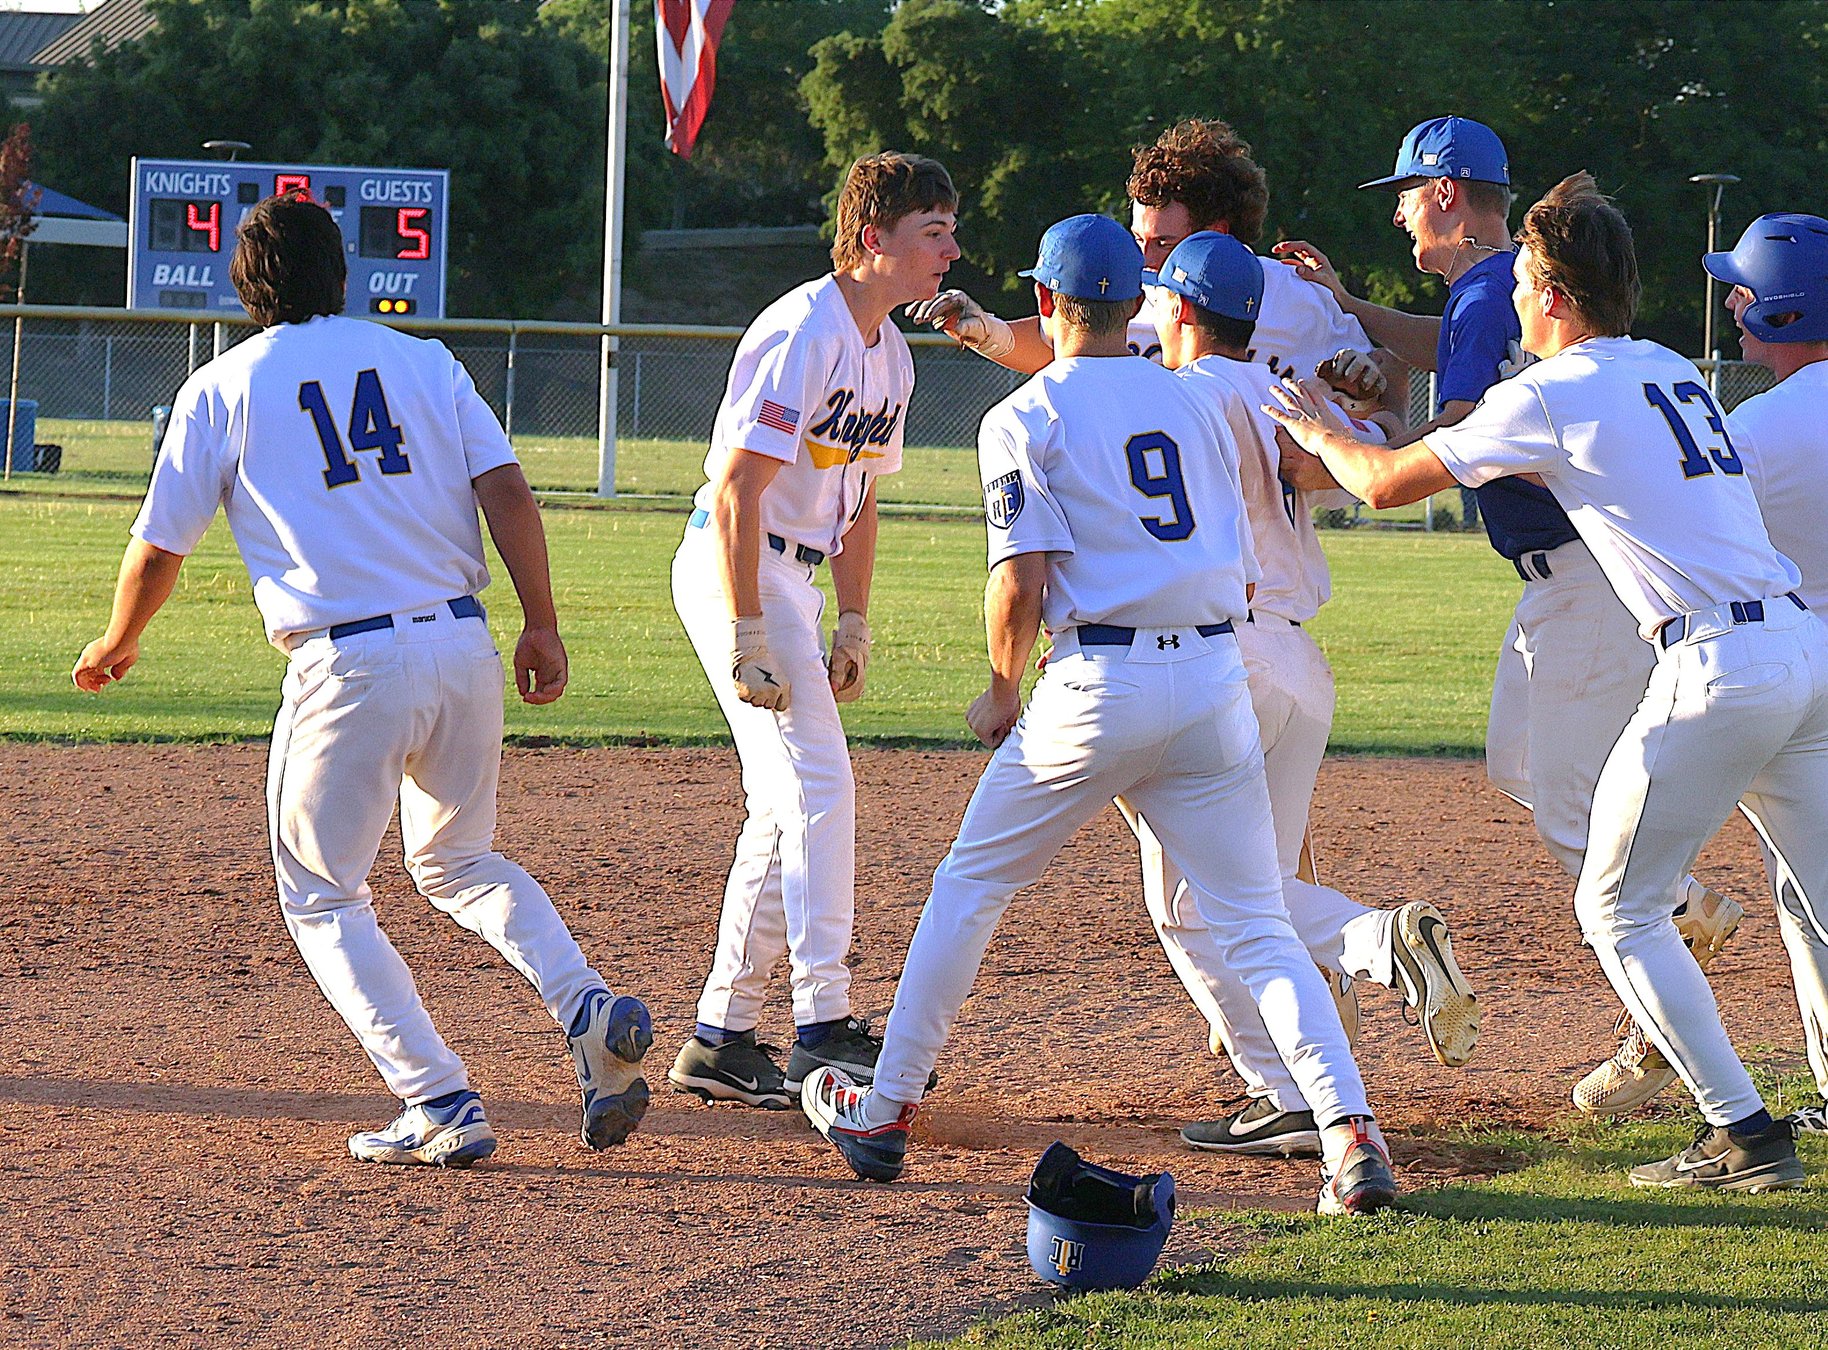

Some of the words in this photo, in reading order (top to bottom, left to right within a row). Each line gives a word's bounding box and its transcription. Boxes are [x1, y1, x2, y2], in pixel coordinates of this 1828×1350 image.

[146, 171, 231, 196] KNIGHTS
[360, 179, 433, 203] GUESTS
[186, 202, 221, 251] 4
[396, 207, 430, 260] 5
[153, 264, 214, 287] BALL
[369, 271, 418, 294] OUT
[298, 368, 412, 490] 14
[1641, 380, 1744, 481] 13
[1123, 429, 1197, 542] 9
